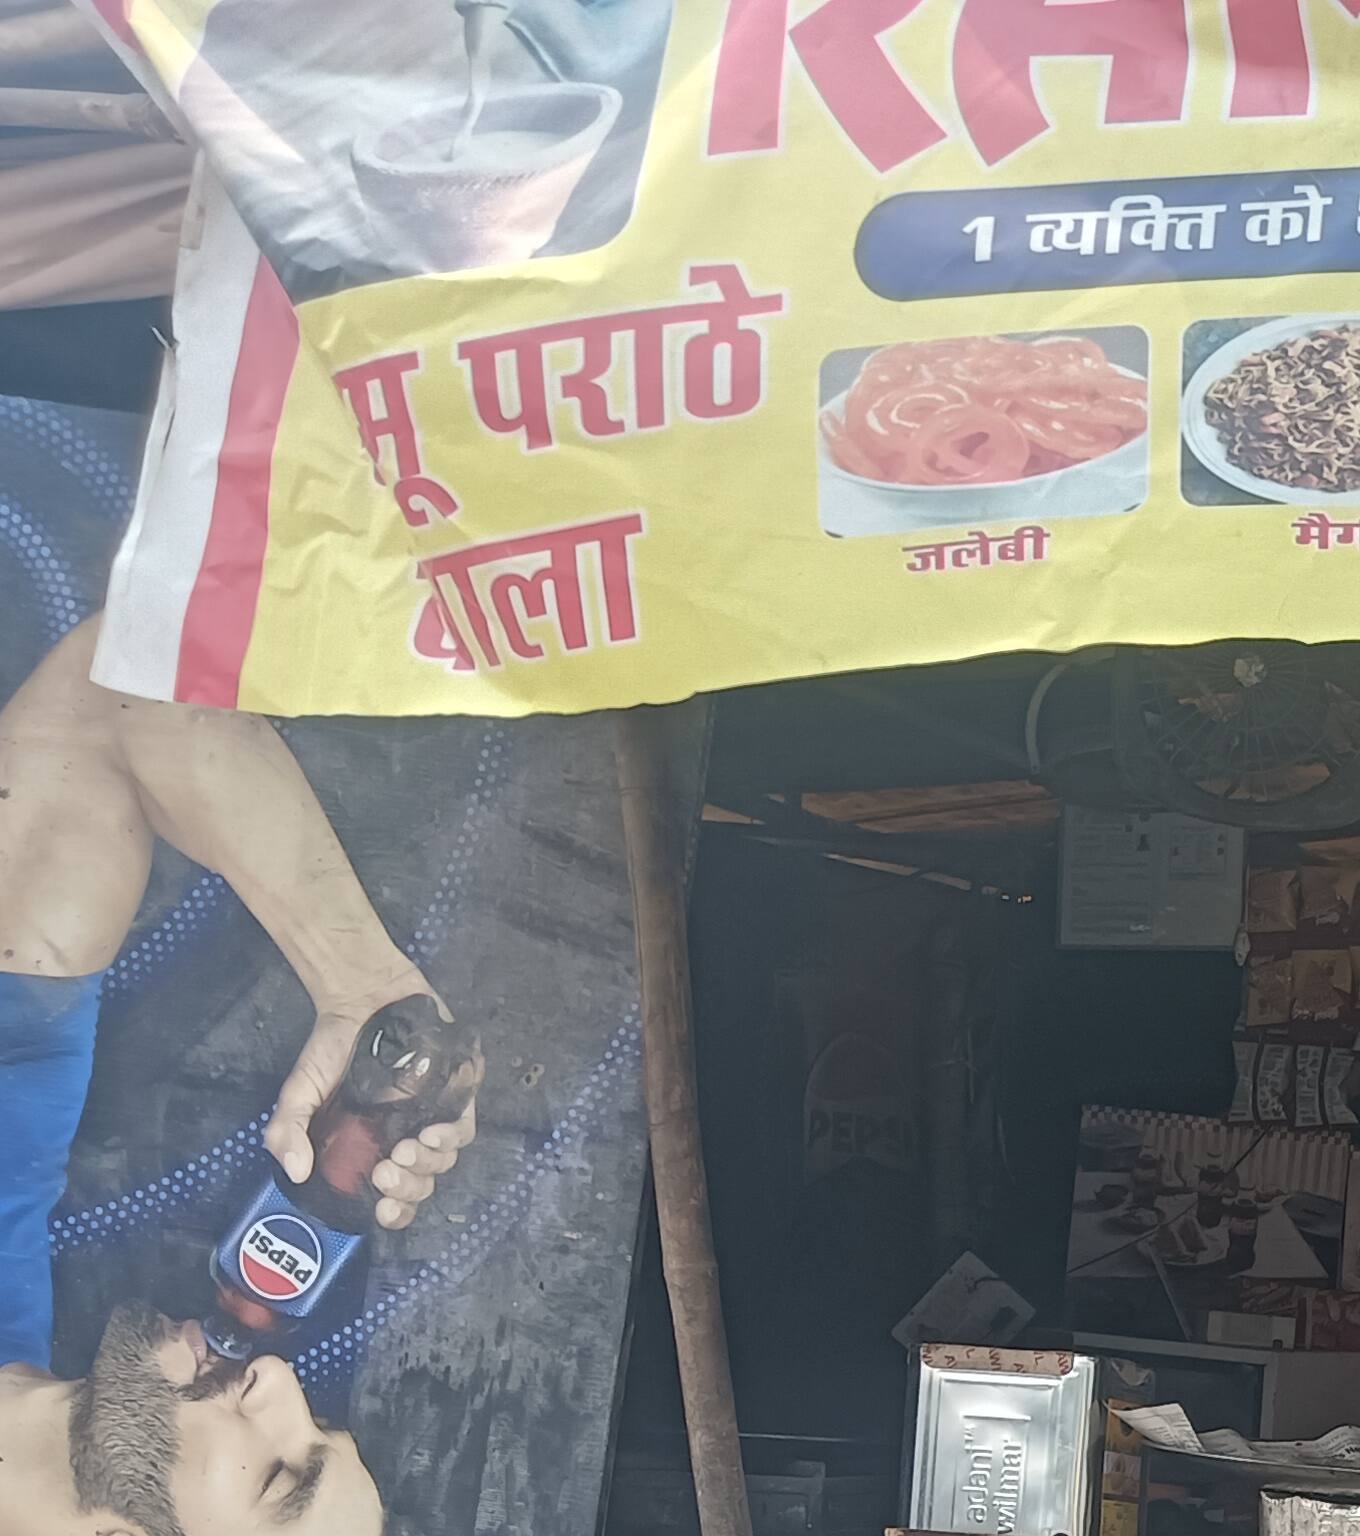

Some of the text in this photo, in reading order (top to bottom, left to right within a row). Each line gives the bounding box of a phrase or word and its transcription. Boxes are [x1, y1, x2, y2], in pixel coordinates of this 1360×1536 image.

[962, 217, 994, 262] 1
[1241, 186, 1333, 246] को
[332, 265, 784, 525] मू पराठे
[902, 526, 1050, 573] जलेबी
[410, 514, 643, 672] वाला
[248, 1229, 313, 1285] PEPSI
